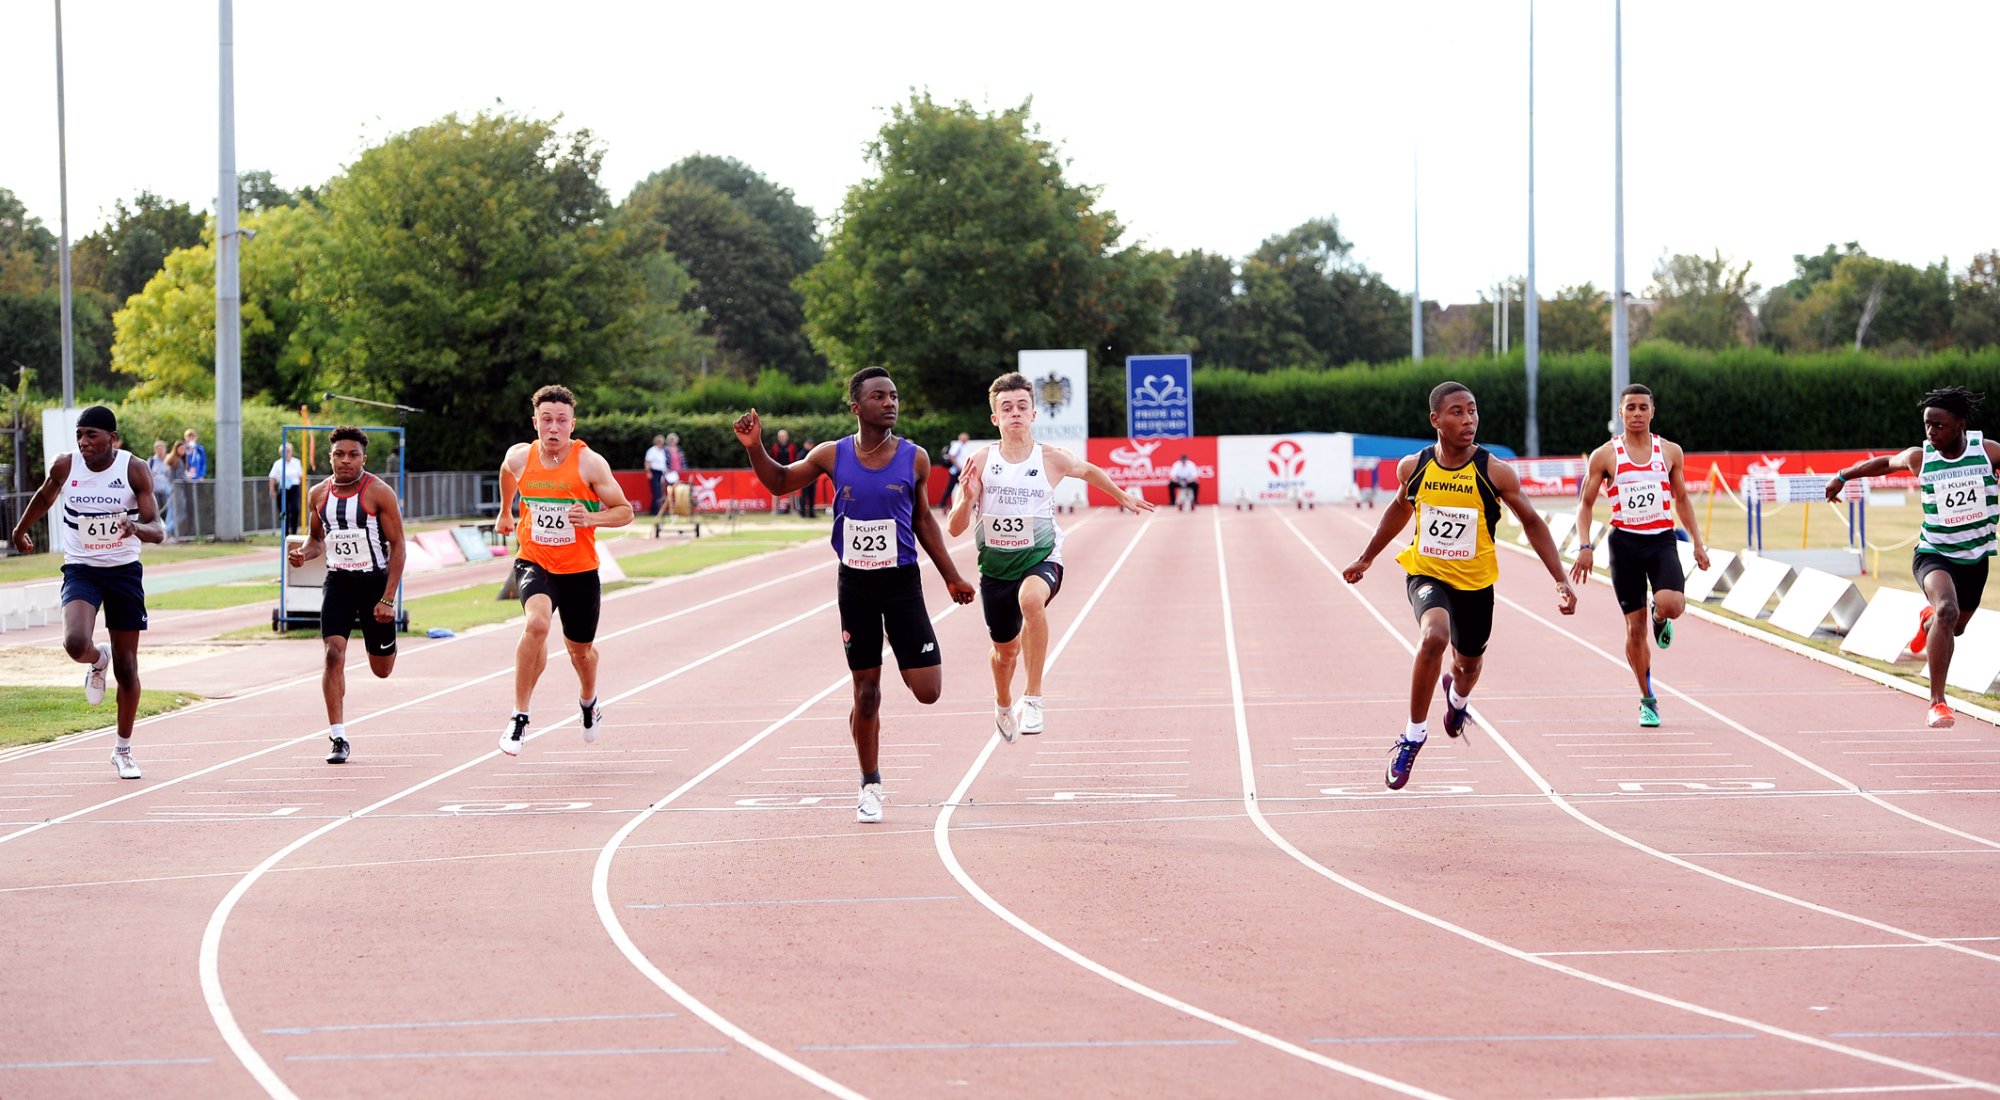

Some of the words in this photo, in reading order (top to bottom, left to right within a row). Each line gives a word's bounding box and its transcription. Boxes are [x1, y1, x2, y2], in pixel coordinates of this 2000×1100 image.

[1170, 409, 1184, 419] IN
[1923, 470, 1963, 483] WOODFORD
[1963, 467, 1988, 476] GREEN
[1424, 481, 1473, 494] NEWHAM
[1630, 484, 1656, 492] KUKRI
[1948, 480, 1977, 489] KUKRI
[986, 486, 1017, 496] NORTHERN
[1018, 488, 1044, 498] IRELAND
[1945, 488, 1977, 508] 624
[70, 496, 121, 504] CROYDON
[1004, 497, 1028, 505] ULSTER
[1628, 492, 1655, 509] 629
[1437, 509, 1470, 520] KUKRI
[1626, 512, 1660, 523] BEDFORD
[1944, 511, 1983, 525] BEDFORD
[537, 514, 565, 529] 626
[992, 517, 1024, 532] 633
[88, 521, 118, 536] 616
[1428, 519, 1467, 539] 627
[84, 541, 123, 550] BEDFORD
[535, 535, 571, 544] BEDFORD
[852, 535, 887, 551] 623
[989, 538, 1029, 547] BEDFORD
[335, 541, 359, 556] 631
[1423, 545, 1470, 558] BEDFORD
[333, 561, 368, 569] BEDFORD
[848, 558, 892, 568] BEDFORD
